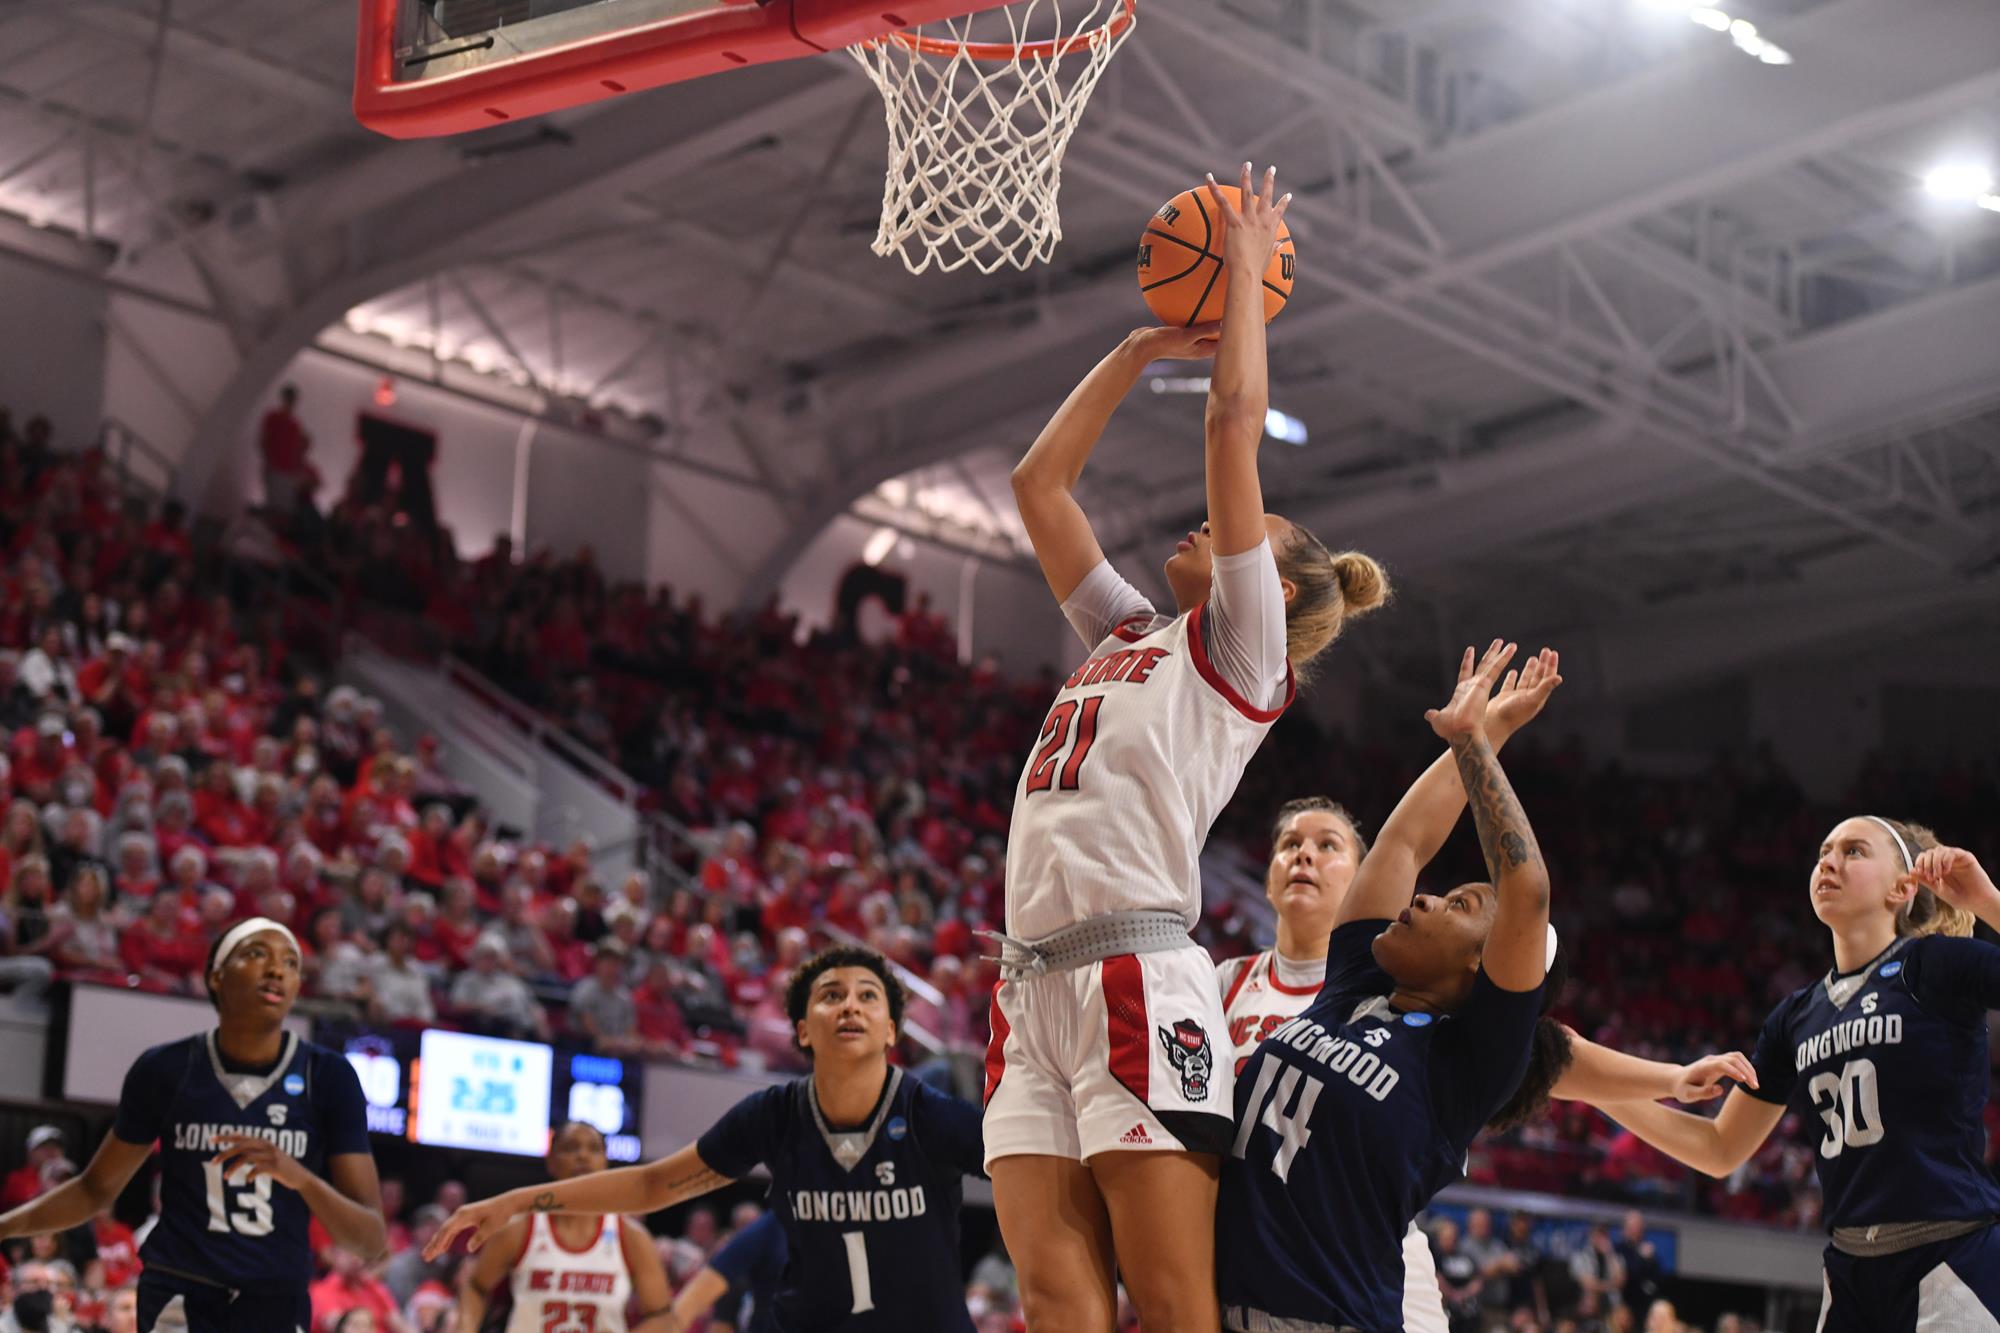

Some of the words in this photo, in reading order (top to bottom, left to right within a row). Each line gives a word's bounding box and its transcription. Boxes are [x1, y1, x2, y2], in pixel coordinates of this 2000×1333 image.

[1065, 647, 1172, 689] STATE
[1026, 695, 1105, 799] 21
[1269, 1018, 1400, 1101] NGWOOD
[1795, 1014, 1902, 1072] ONGWOOD
[1119, 1135, 1153, 1145] adidas
[1232, 1052, 1325, 1184] 14
[1808, 1058, 1885, 1159] 30
[201, 1161, 275, 1236] 13
[787, 1185, 927, 1222] ONGWOOD
[559, 1271, 617, 1295] STATE
[841, 1231, 875, 1314] 1
[543, 1301, 598, 1333] 23
